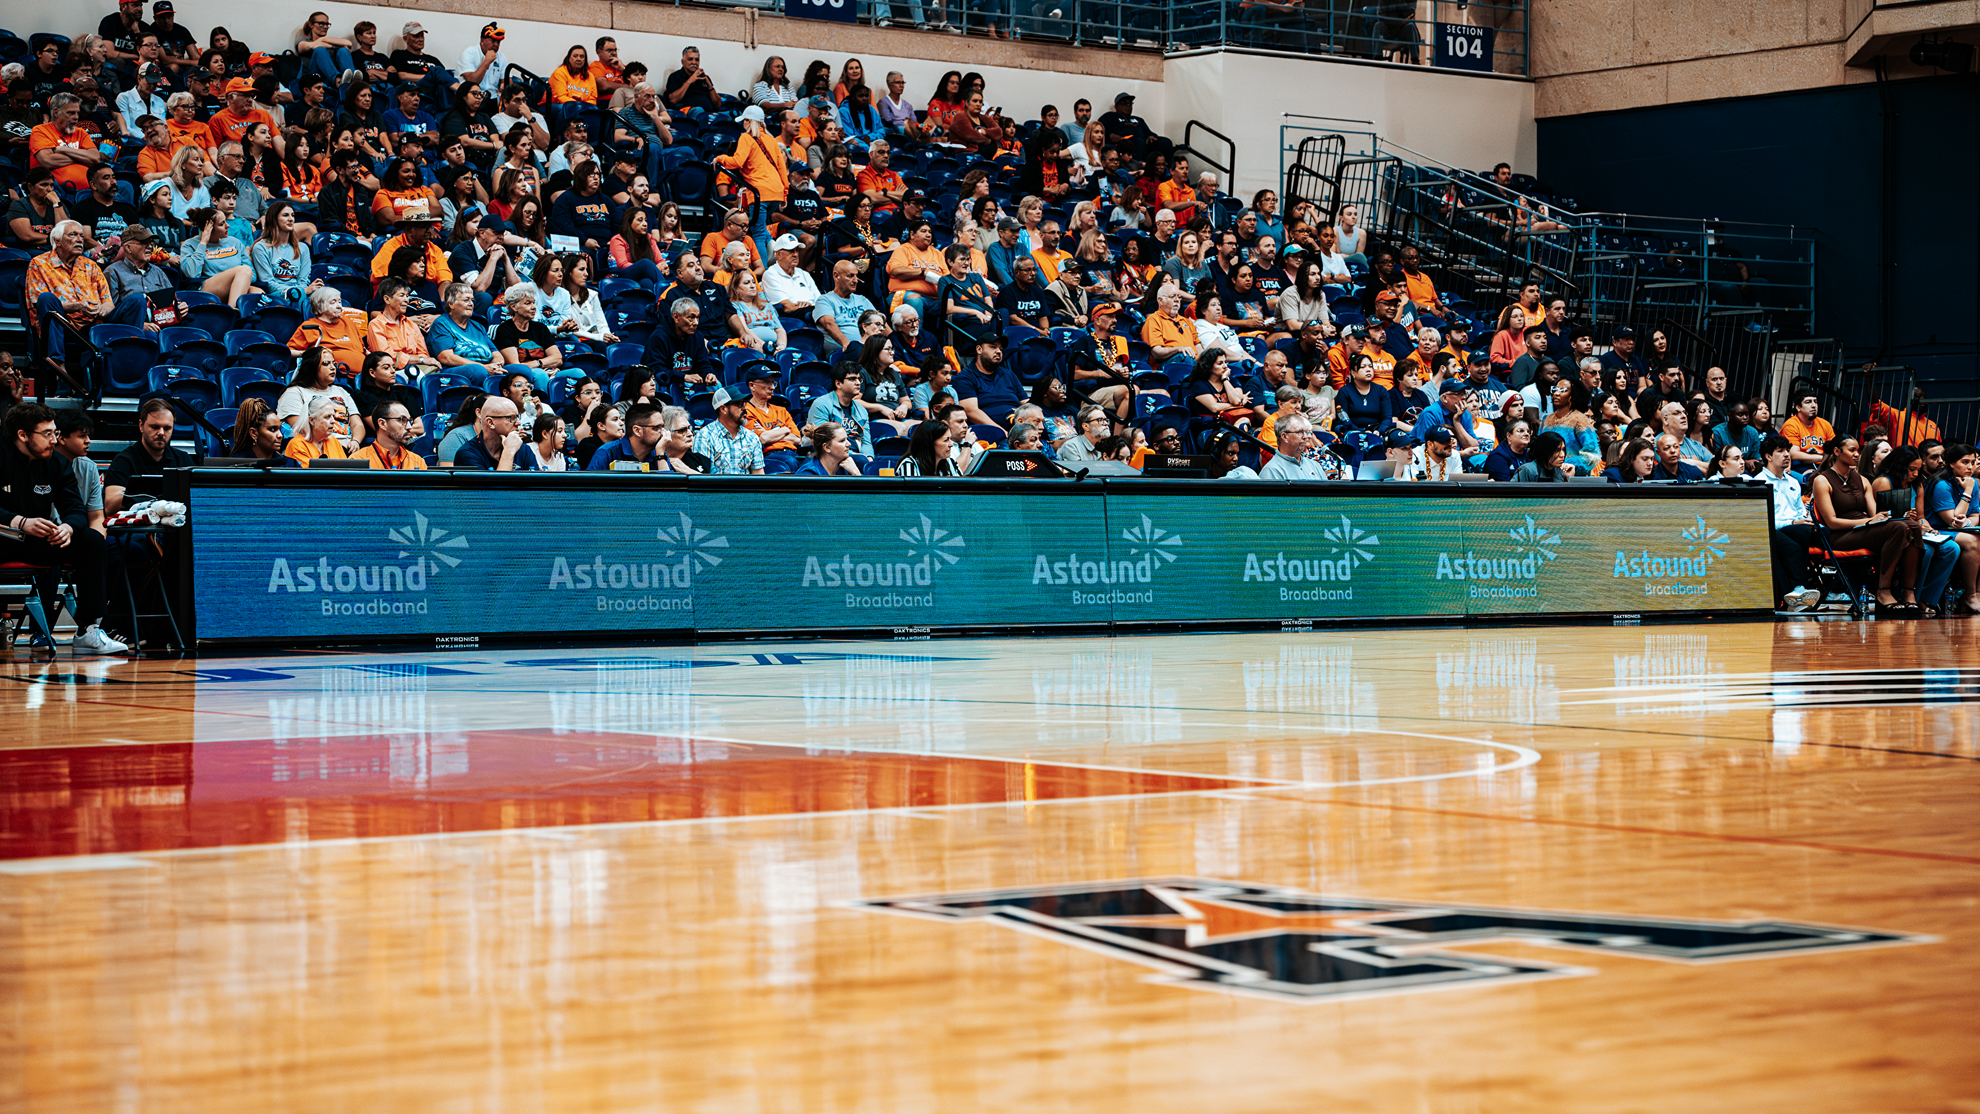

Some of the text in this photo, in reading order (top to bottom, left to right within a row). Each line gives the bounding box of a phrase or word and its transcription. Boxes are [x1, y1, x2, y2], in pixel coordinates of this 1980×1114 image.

[1446, 24, 1483, 36] SECTION
[114, 38, 135, 50] UTS
[1446, 36, 1483, 59] 104
[942, 110, 957, 120] UTS
[575, 203, 609, 215] UTSA
[793, 198, 818, 208] UTSA
[31, 224, 55, 235] UTS
[1261, 280, 1282, 289] UTSA
[1016, 300, 1041, 310] UTSA
[875, 384, 900, 403] 85
[1801, 434, 1824, 448] UTSA
[1005, 461, 1025, 471] POSS
[801, 553, 932, 587] Astound
[1032, 552, 1152, 585] Astound
[1243, 551, 1352, 582] Astound
[1435, 550, 1536, 580] Astound
[1613, 549, 1708, 578] Astound
[267, 555, 427, 593] Astound
[548, 553, 691, 590] Astound
[1279, 586, 1353, 601] Broadband
[1470, 585, 1537, 599] Broadband
[1645, 581, 1708, 595] Broadband
[596, 594, 693, 611] Broadband
[845, 592, 934, 608] Broadband
[1072, 589, 1153, 605] Broadband
[321, 598, 428, 615] Broadband
